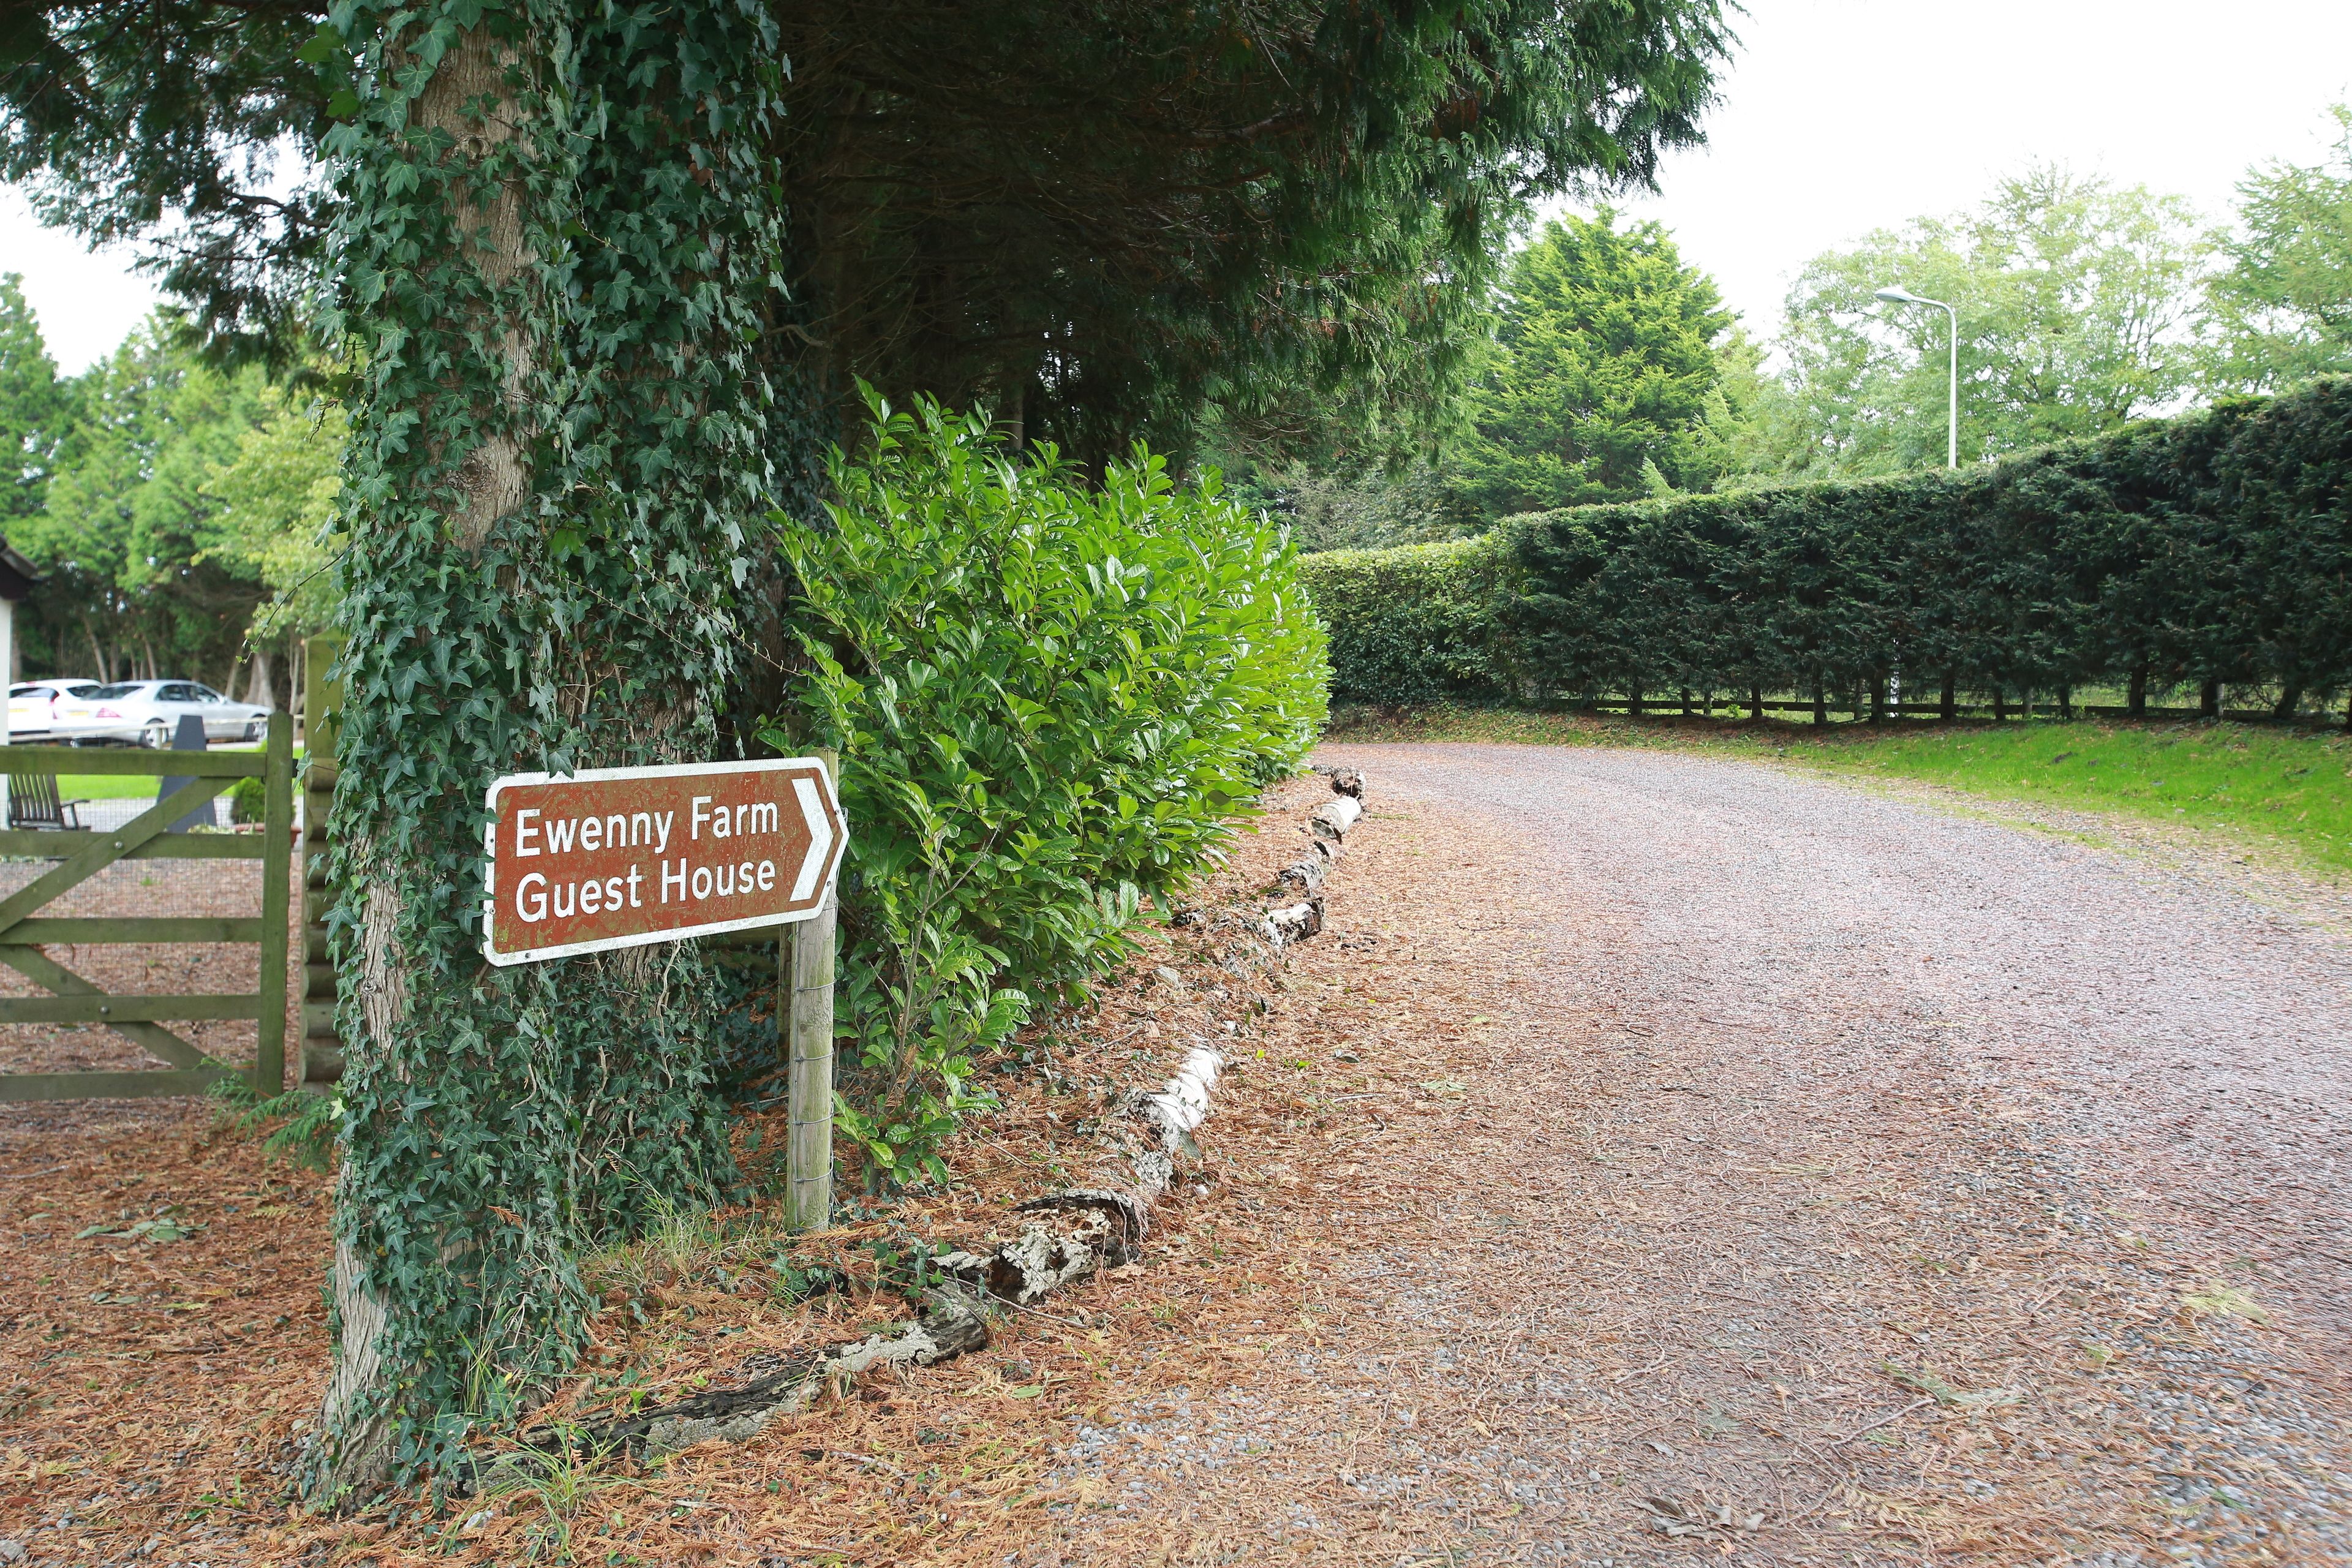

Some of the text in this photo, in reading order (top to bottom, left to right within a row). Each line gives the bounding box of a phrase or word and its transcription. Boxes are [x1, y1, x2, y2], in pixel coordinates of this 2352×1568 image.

[516, 796, 778, 858] Ewenny Farm
[515, 858, 775, 922] Guest House
